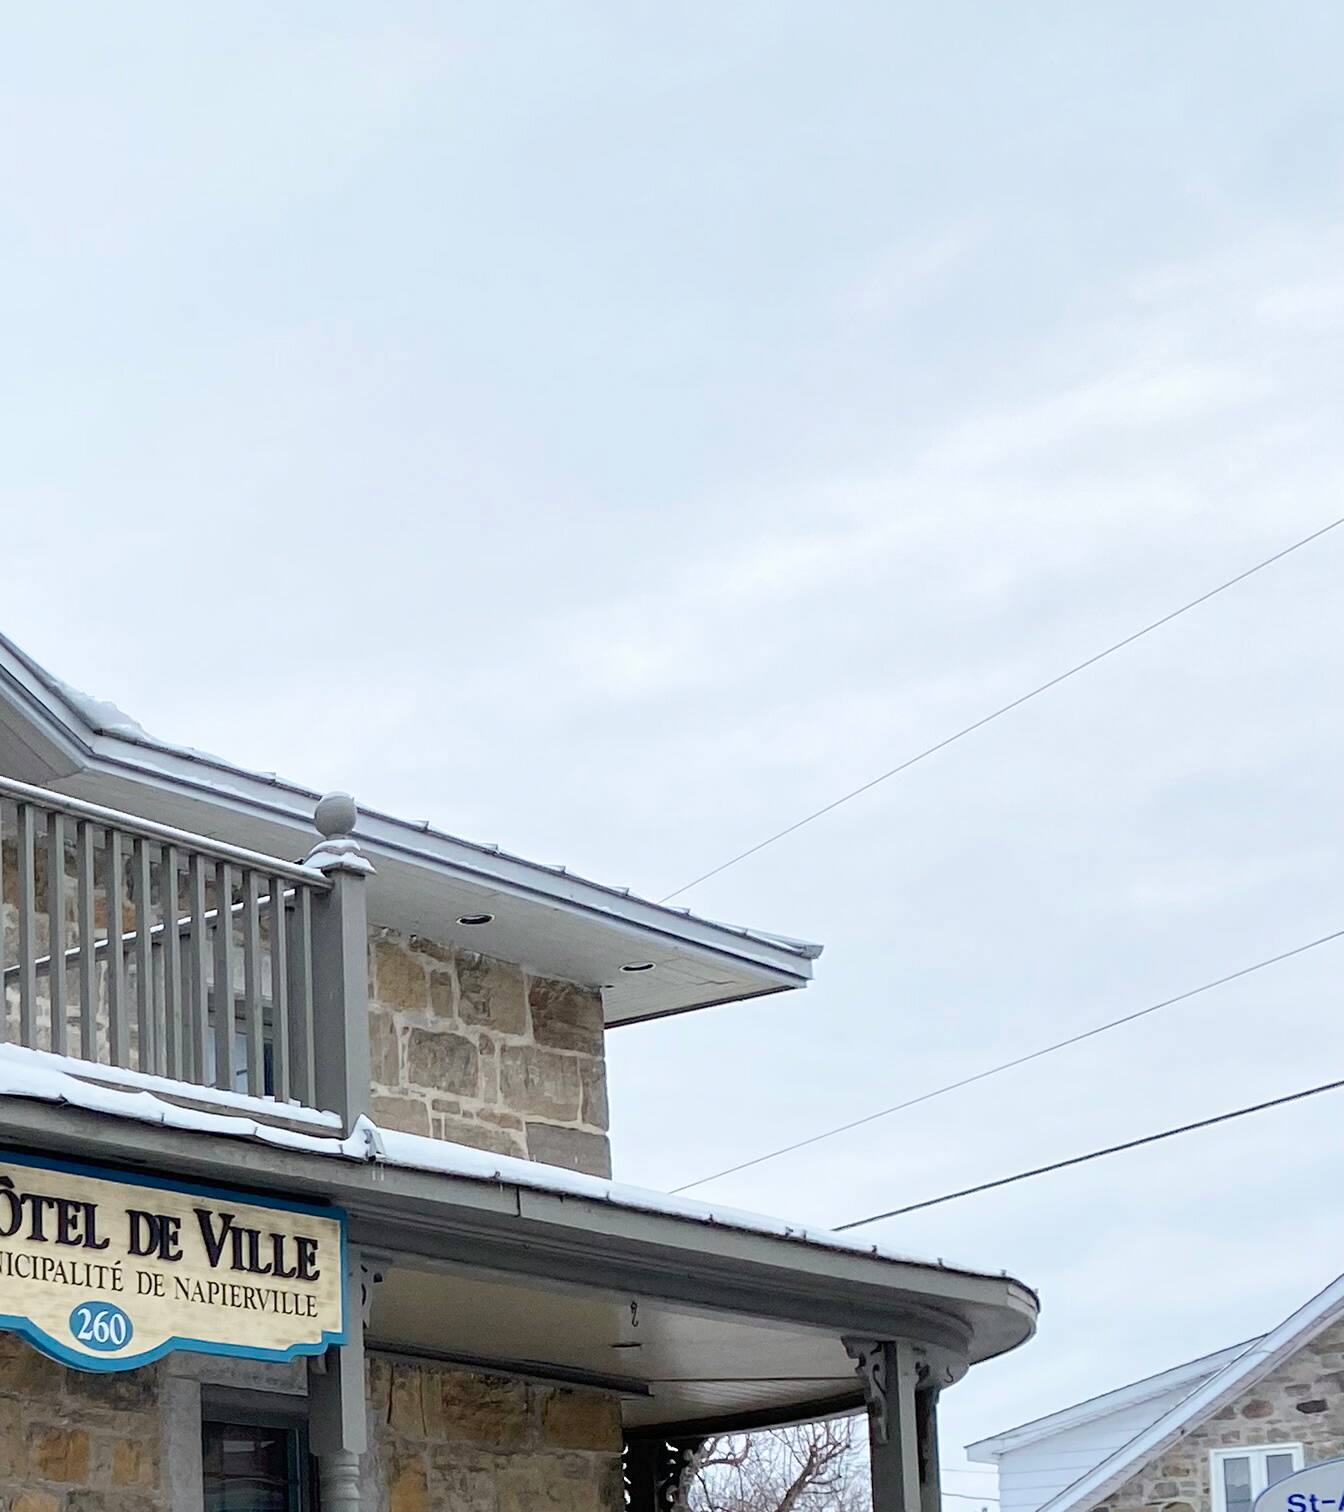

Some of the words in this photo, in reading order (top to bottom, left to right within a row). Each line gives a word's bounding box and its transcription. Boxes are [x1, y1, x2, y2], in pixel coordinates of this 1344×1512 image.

[125, 1209, 184, 1262] DE
[193, 1208, 321, 1281] VILLE
[136, 1270, 165, 1297] DE
[174, 1276, 318, 1318] NAPIERVILLE
[77, 1308, 127, 1345] 260
